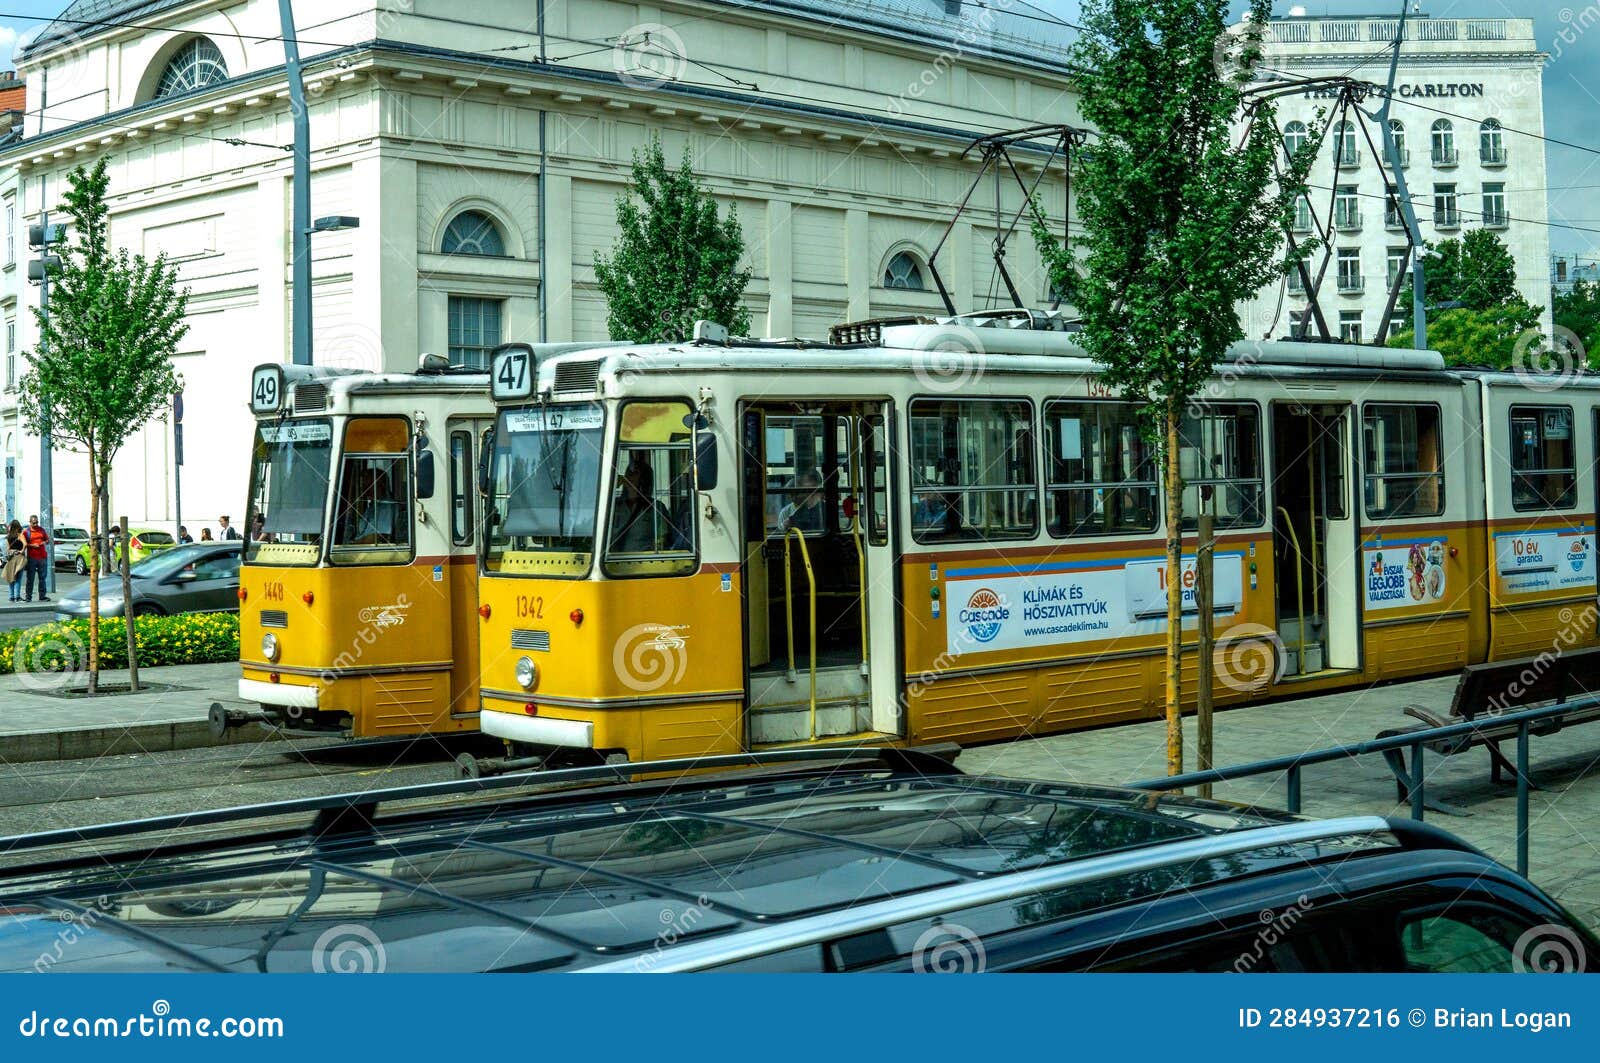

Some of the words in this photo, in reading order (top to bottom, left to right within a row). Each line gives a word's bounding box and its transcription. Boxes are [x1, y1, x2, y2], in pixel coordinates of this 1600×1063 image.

[498, 354, 528, 390] 47
[255, 376, 277, 405] 49
[550, 414, 563, 428] 47
[1512, 540, 1524, 555] 10
[1517, 553, 1543, 566] garancia
[264, 582, 284, 601] 1448
[1368, 574, 1405, 592] LEGJOBB
[1023, 586, 1066, 604] KLÍMÁK
[1069, 584, 1083, 600] ÉS
[516, 595, 544, 620] 1342
[959, 607, 1010, 624] Cascade
